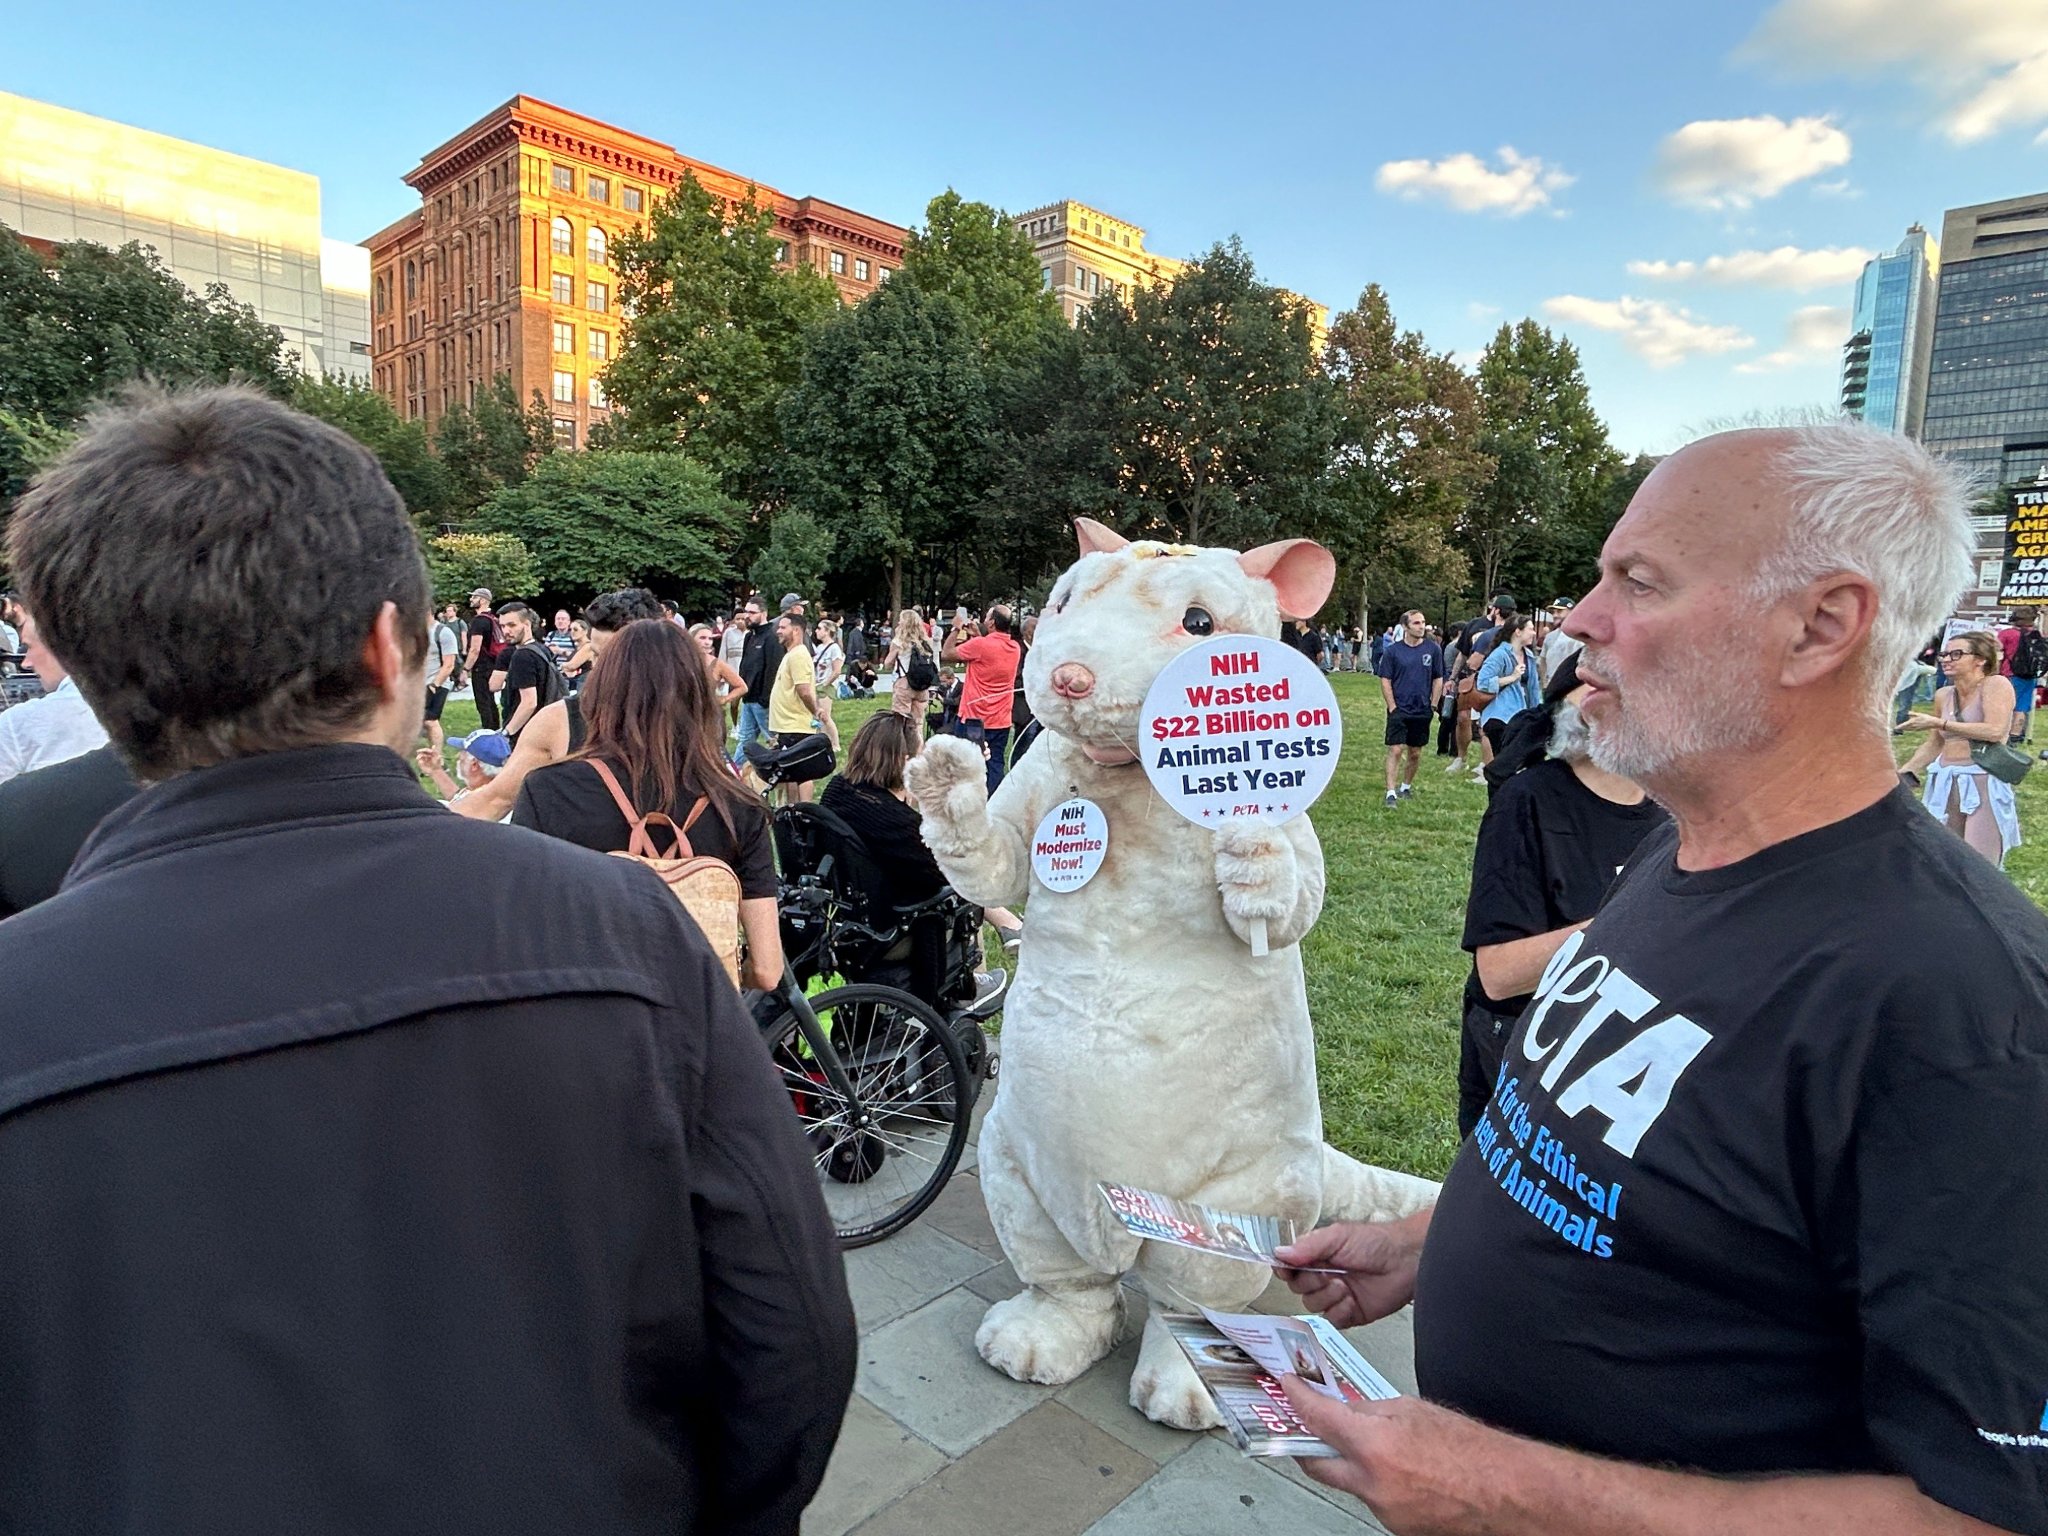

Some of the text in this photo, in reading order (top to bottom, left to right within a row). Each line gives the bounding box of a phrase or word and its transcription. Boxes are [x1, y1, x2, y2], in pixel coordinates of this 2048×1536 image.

[1211, 652, 1259, 676] NIH
[1186, 678, 1290, 708] Wasted
[1152, 708, 1330, 741] $22 Billion on
[1157, 737, 1330, 768] Animal Tests
[1182, 769, 1305, 795] Last Year
[1061, 806, 1085, 820] NIH
[1055, 822, 1086, 837] Must
[1036, 838, 1102, 855] Modernize
[1051, 855, 1083, 871] Now!
[1498, 1077, 1519, 1120] for
[1509, 1102, 1532, 1149] the
[1530, 1125, 1622, 1221] Ethical
[1489, 1147, 1514, 1179] of
[1110, 1188, 1146, 1205] CUT
[1501, 1159, 1613, 1258] Animals
[1251, 1404, 1288, 1433] CUT
[1977, 1428, 2016, 1446] People
